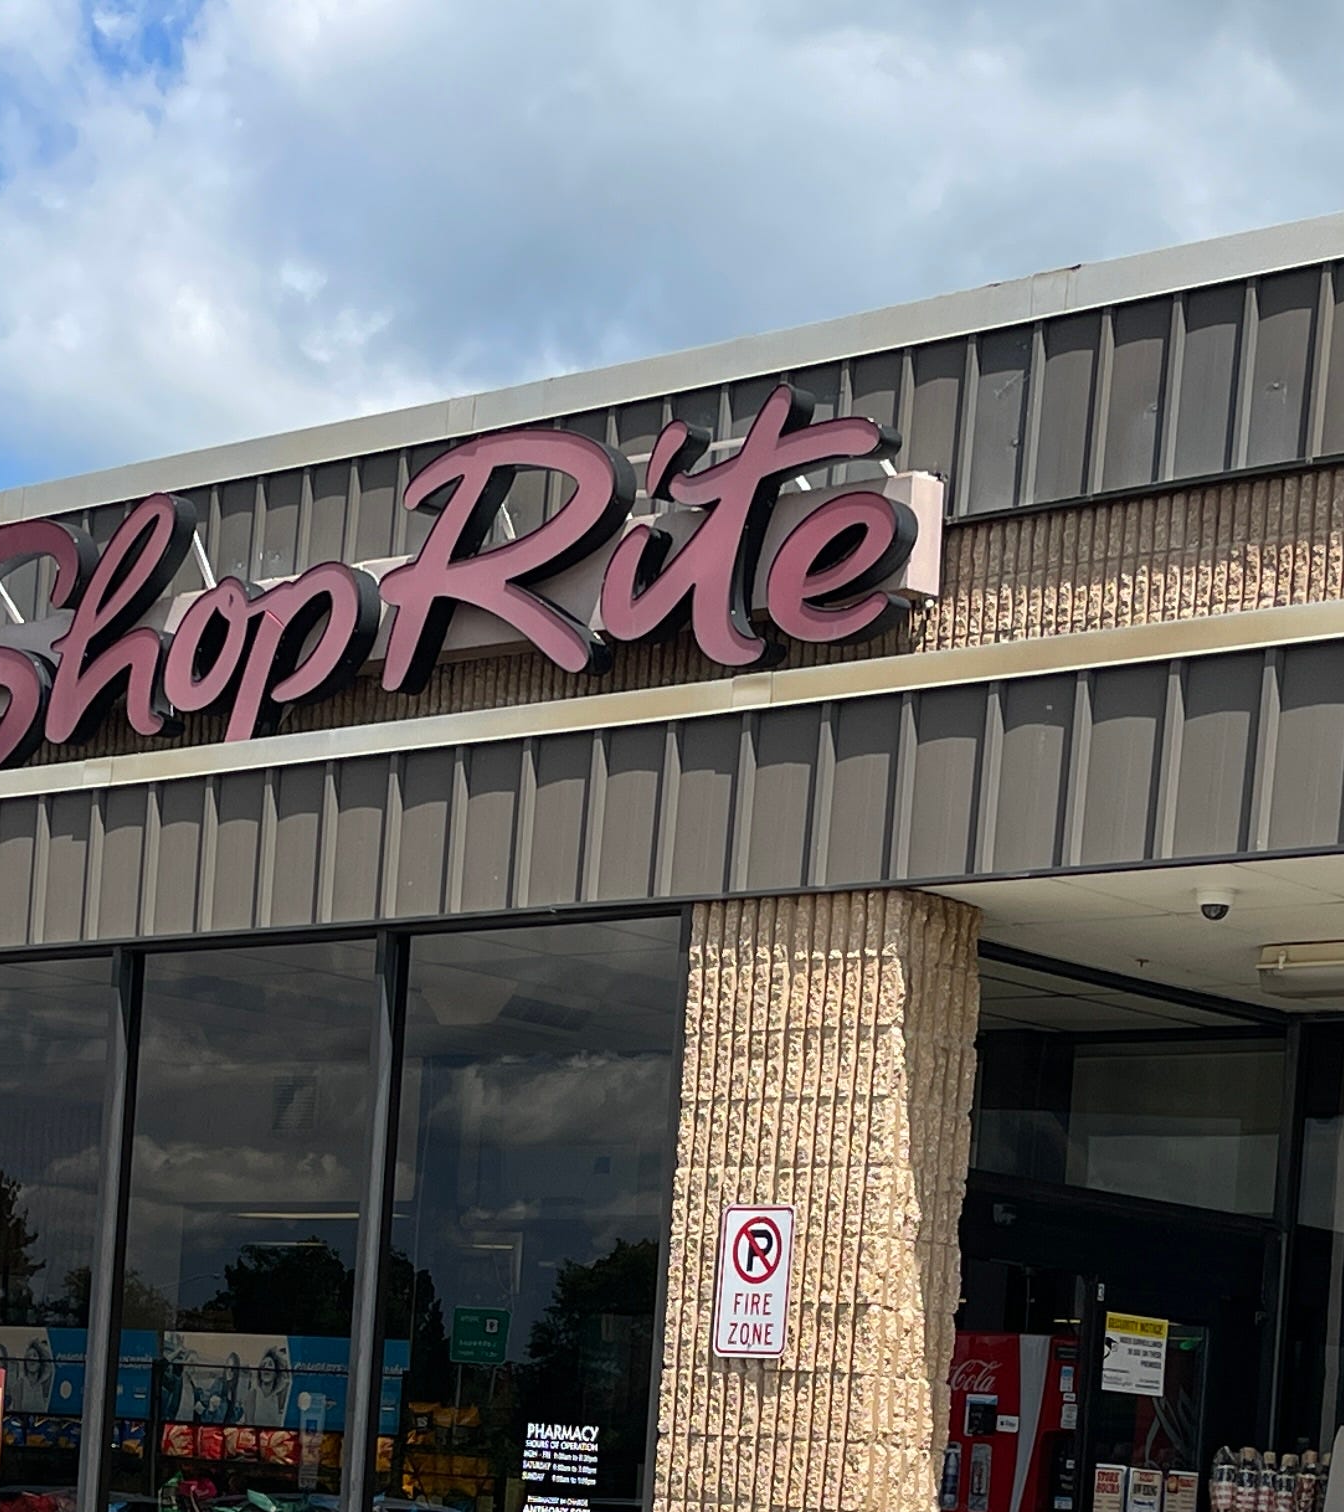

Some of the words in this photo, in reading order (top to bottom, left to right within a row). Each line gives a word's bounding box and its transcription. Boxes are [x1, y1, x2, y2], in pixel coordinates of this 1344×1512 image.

[733, 1292, 773, 1315] FIRE
[728, 1323, 774, 1345] ZONE
[951, 1360, 1002, 1392] Cola
[527, 1422, 599, 1441] PHARMACY
[525, 1440, 549, 1449] HOURS
[550, 1441, 559, 1449] OF
[560, 1441, 598, 1451] OPERATION
